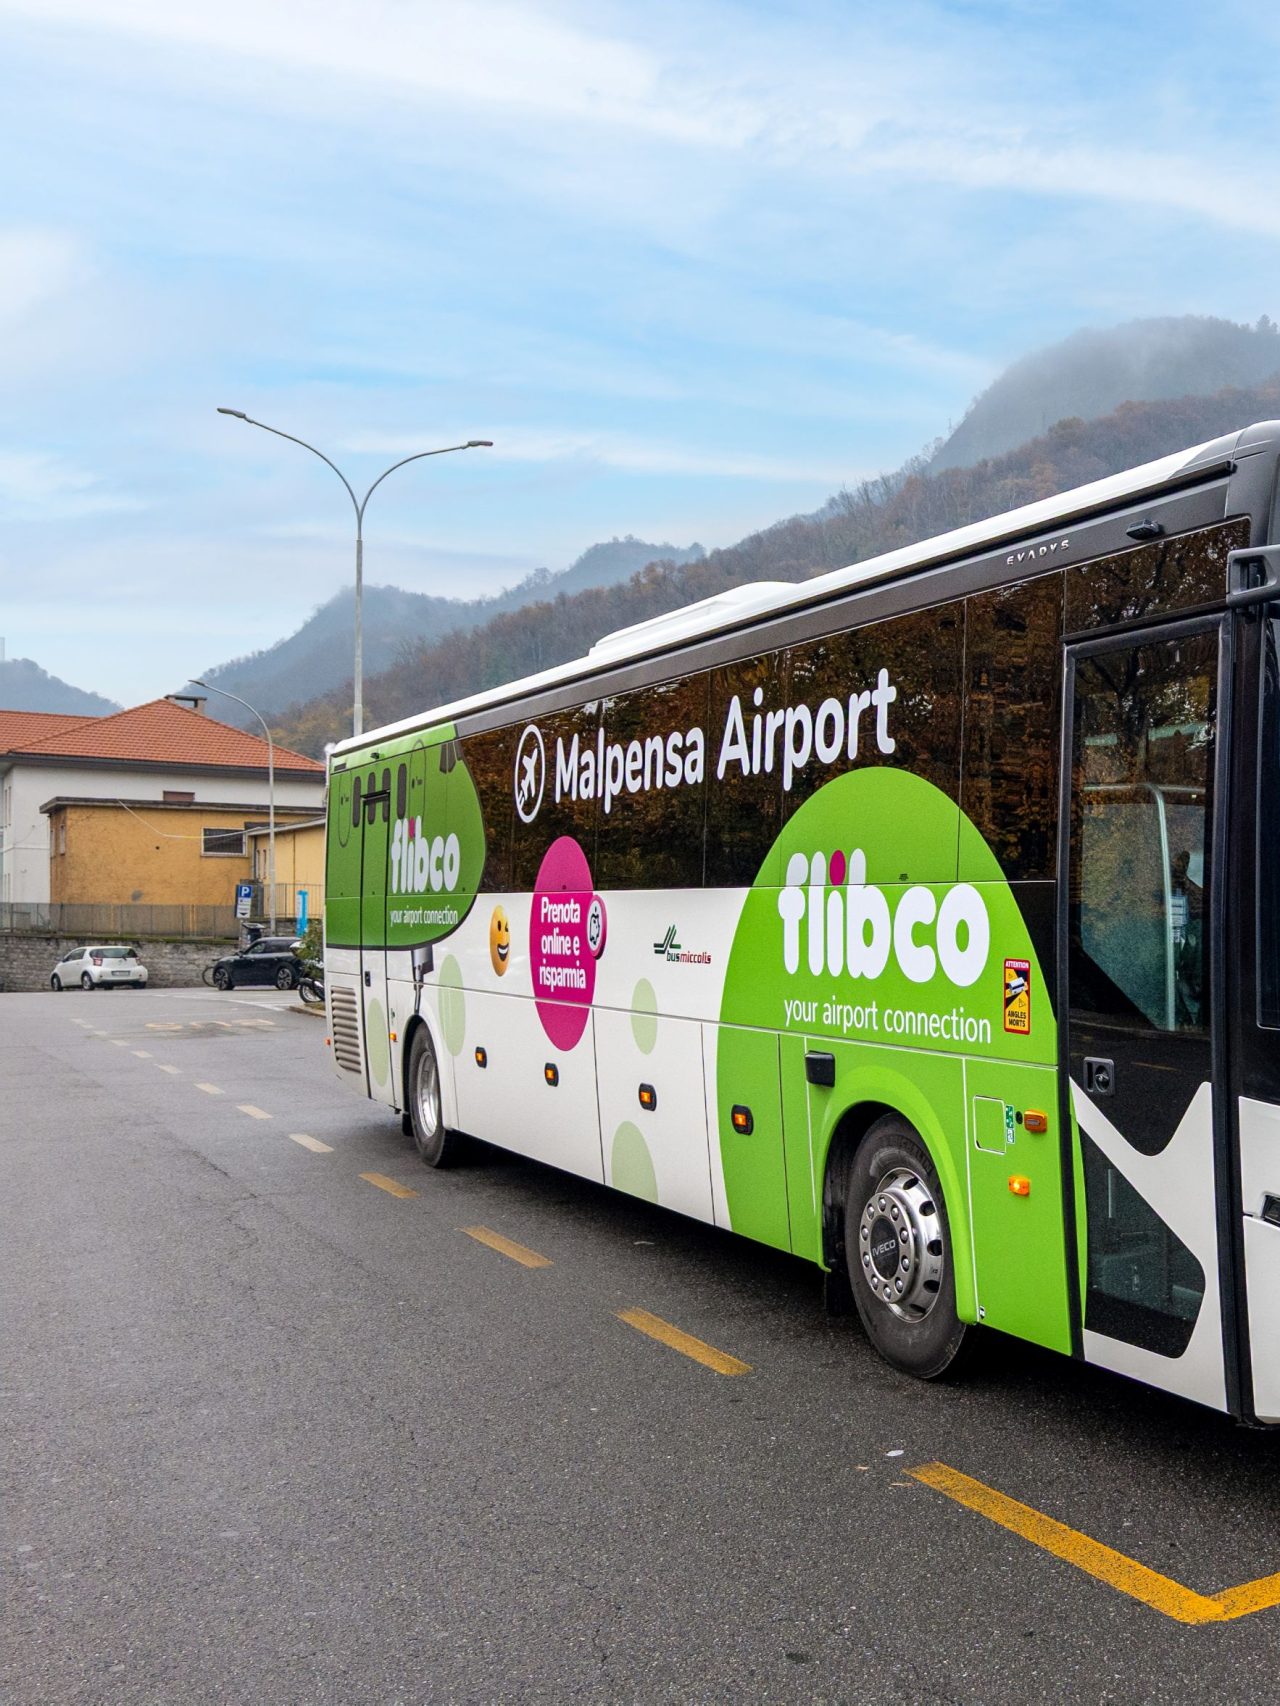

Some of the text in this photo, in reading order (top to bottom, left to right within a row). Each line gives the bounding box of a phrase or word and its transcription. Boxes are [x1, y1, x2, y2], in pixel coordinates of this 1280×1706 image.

[555, 668, 897, 814] Malpensa Airport
[391, 815, 460, 894] flibco
[241, 886, 250, 897] P
[390, 905, 458, 927] your airport connection
[541, 896, 581, 923] Prenota
[777, 848, 990, 987] flibco
[541, 927, 580, 956] online e
[666, 950, 712, 964] busmiccolis
[539, 958, 587, 992] risparmia
[784, 995, 991, 1043] your airport connection
[1008, 1010, 1026, 1019] ANGLES
[1008, 1018, 1026, 1027] MORTS
[872, 1239, 896, 1257] IVECO
